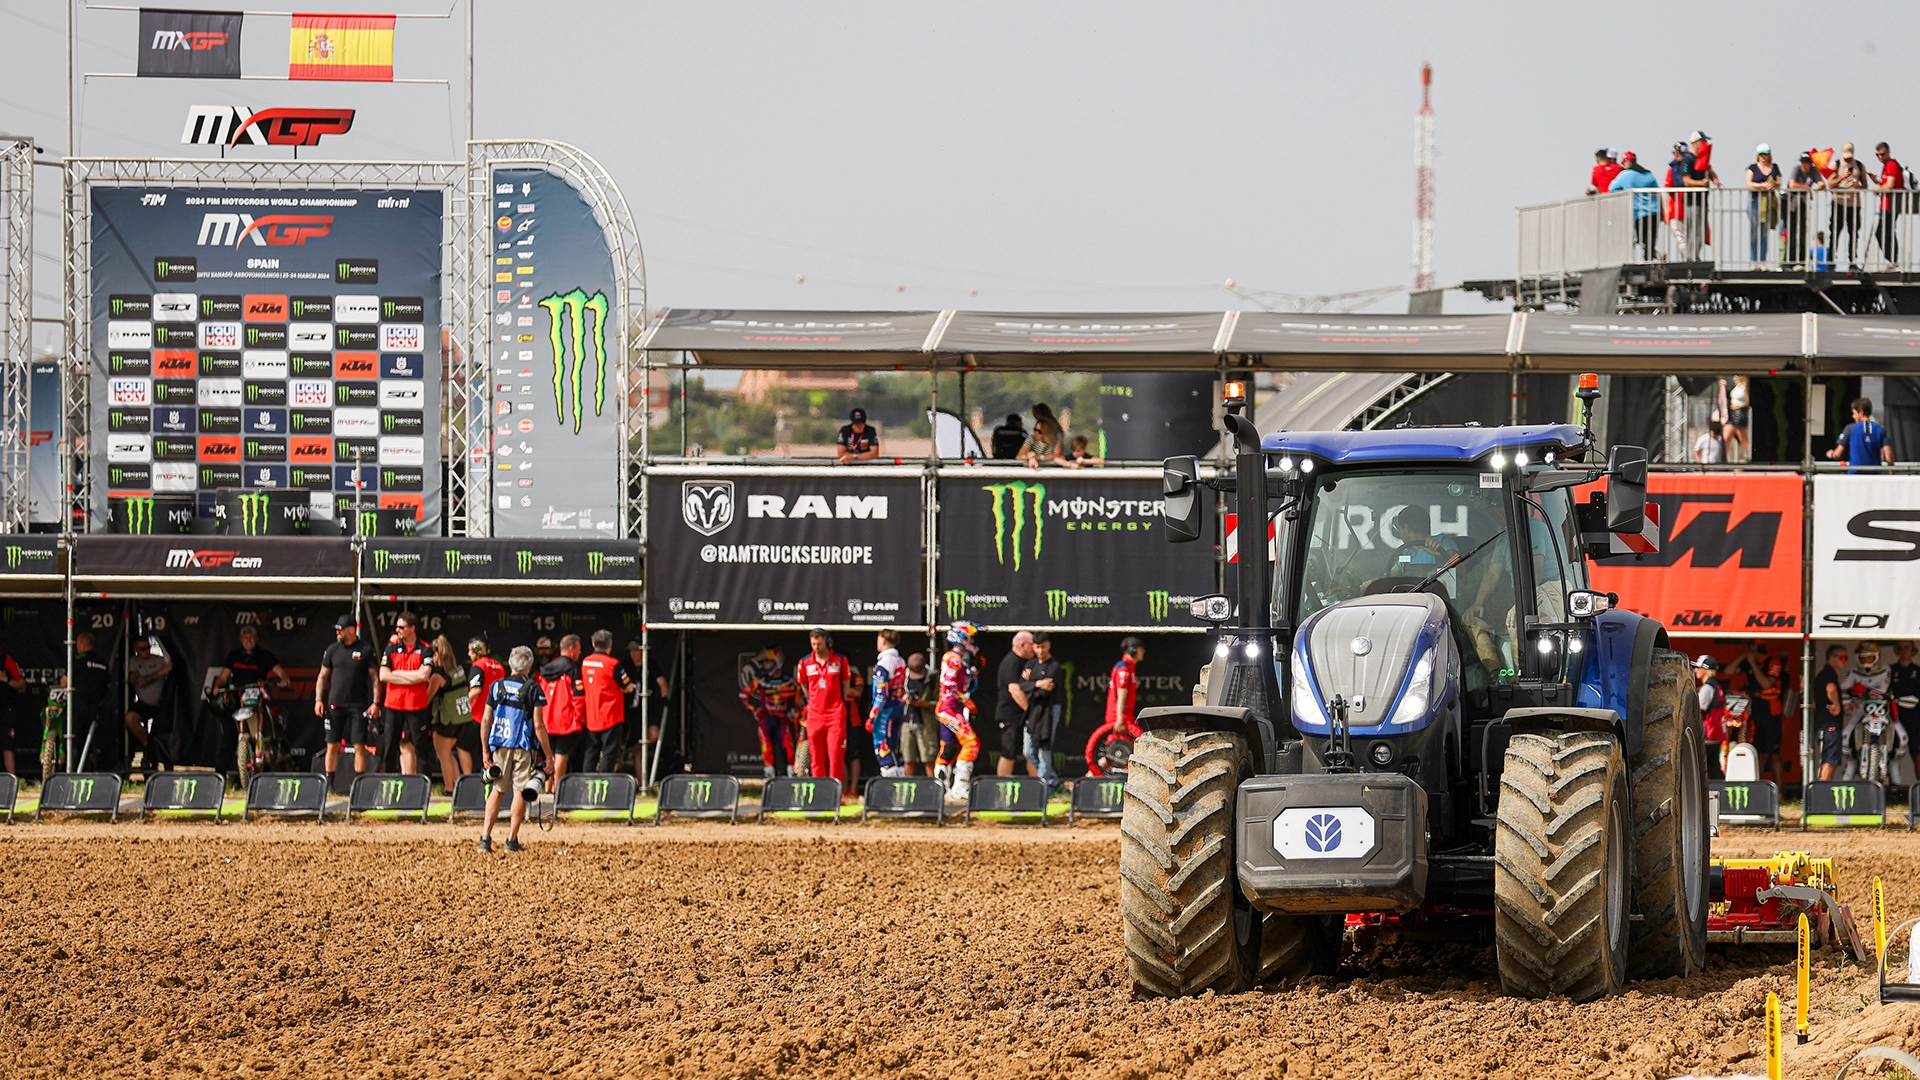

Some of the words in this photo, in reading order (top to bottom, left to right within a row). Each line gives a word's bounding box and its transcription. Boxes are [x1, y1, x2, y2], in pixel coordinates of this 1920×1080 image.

[151, 30, 229, 51] MXGP
[181, 104, 356, 150] MXGP
[185, 197, 205, 206] 2024
[206, 197, 220, 206] FIM
[221, 198, 270, 207] MOTOCROSS
[271, 198, 298, 207] WORLD
[299, 198, 357, 208] CHAMPIONSHIP
[197, 213, 335, 252] MXGP
[247, 258, 280, 269] SPAIN
[249, 303, 282, 314] KTM
[205, 325, 236, 336] LIQUI
[386, 327, 418, 338] LIQUI
[204, 335, 236, 346] MOLY
[386, 337, 418, 348] MOLY
[158, 359, 192, 370] KTM
[340, 361, 374, 371] KTM
[114, 381, 145, 392] LIQUI
[295, 383, 326, 393] LIQUI
[114, 391, 145, 402] MOLY
[295, 392, 326, 404] MOLY
[203, 444, 237, 455] KTM
[294, 445, 328, 456] KTM
[747, 494, 889, 519] RAM
[1048, 496, 1167, 520] MONSTER
[1066, 521, 1153, 531] ENERGY
[700, 544, 873, 565] @RAMTRUCKSEUROPE
[684, 601, 720, 610] RAM
[773, 602, 809, 611] RAM
[863, 602, 899, 611] RAM
[92, 613, 114, 628] 20
[145, 616, 166, 631] 19
[272, 616, 294, 631] 18
[377, 612, 397, 627] 17
[421, 615, 442, 630] 16
[534, 616, 555, 630] 15
[1672, 610, 1723, 627] KTM
[1746, 611, 1796, 628] KTM
[1866, 703, 1886, 716] 96
